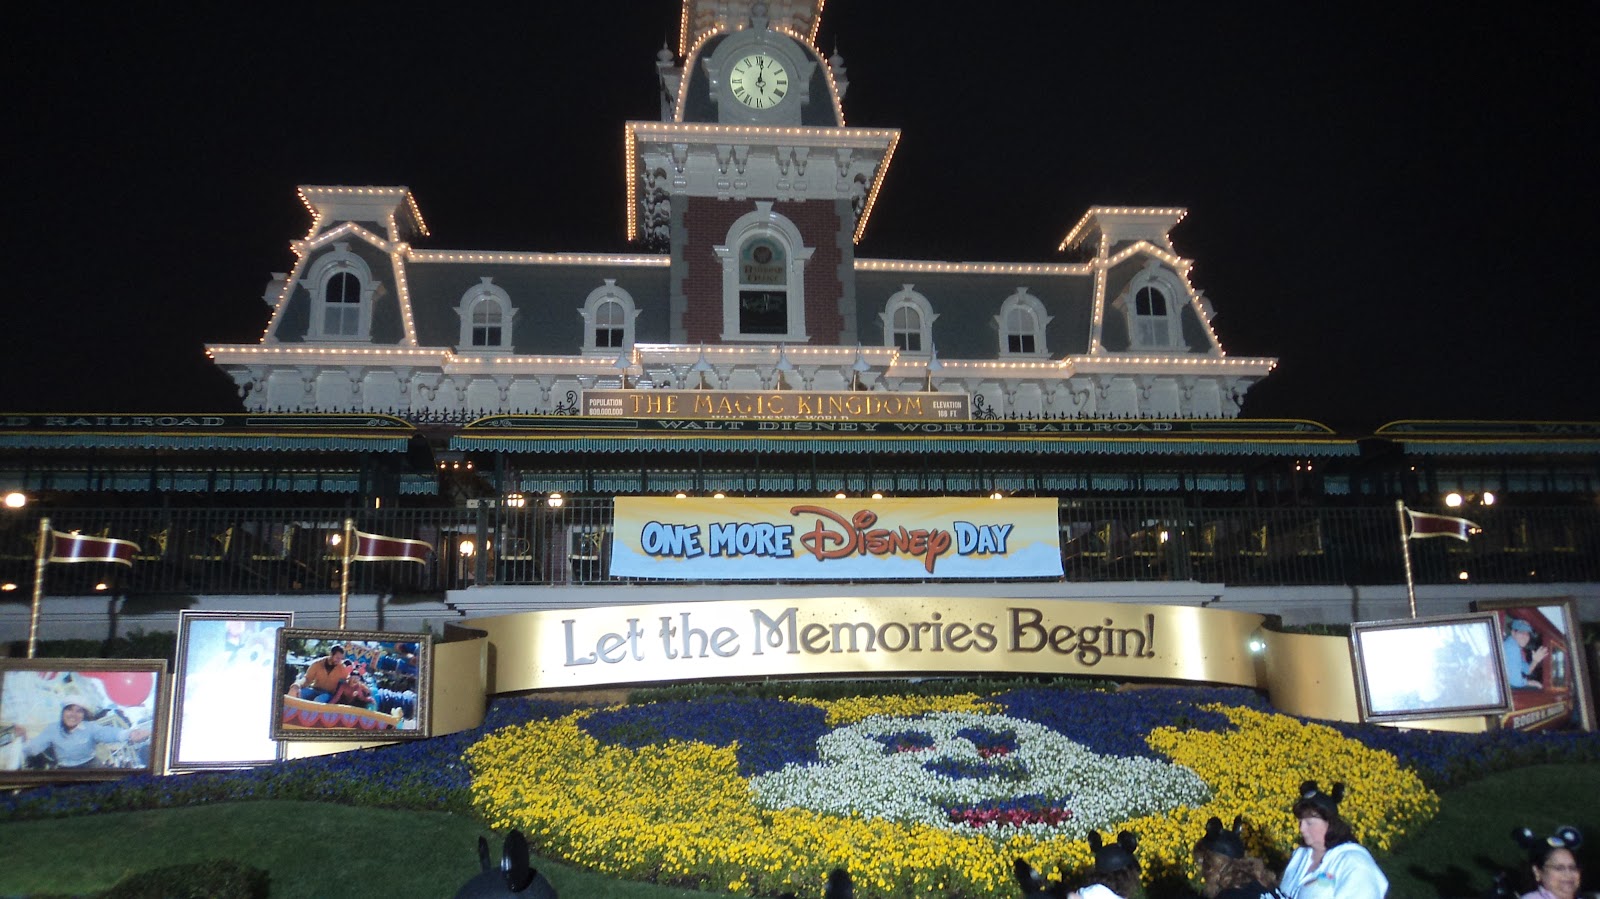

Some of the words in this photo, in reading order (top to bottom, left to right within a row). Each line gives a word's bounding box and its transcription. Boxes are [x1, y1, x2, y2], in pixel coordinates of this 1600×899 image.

[589, 398, 623, 407] POPULATION
[630, 394, 679, 414] THE
[694, 394, 784, 415] MAGIC
[798, 395, 924, 416] KINGDOM
[933, 400, 962, 409] ELEVATION
[45, 416, 225, 427] RAILROAD
[657, 420, 745, 430] WALT
[757, 421, 880, 431] DISNEY
[895, 422, 1005, 432] WORLD
[1017, 422, 1173, 432] RAILROAD
[640, 520, 703, 559] ONE
[708, 521, 794, 558] MORE
[790, 504, 952, 574] Disney
[953, 521, 1015, 555] DAY
[562, 618, 645, 667] Let
[659, 612, 740, 660] the
[750, 606, 999, 656] Memories
[1006, 607, 1156, 667] Begin!
